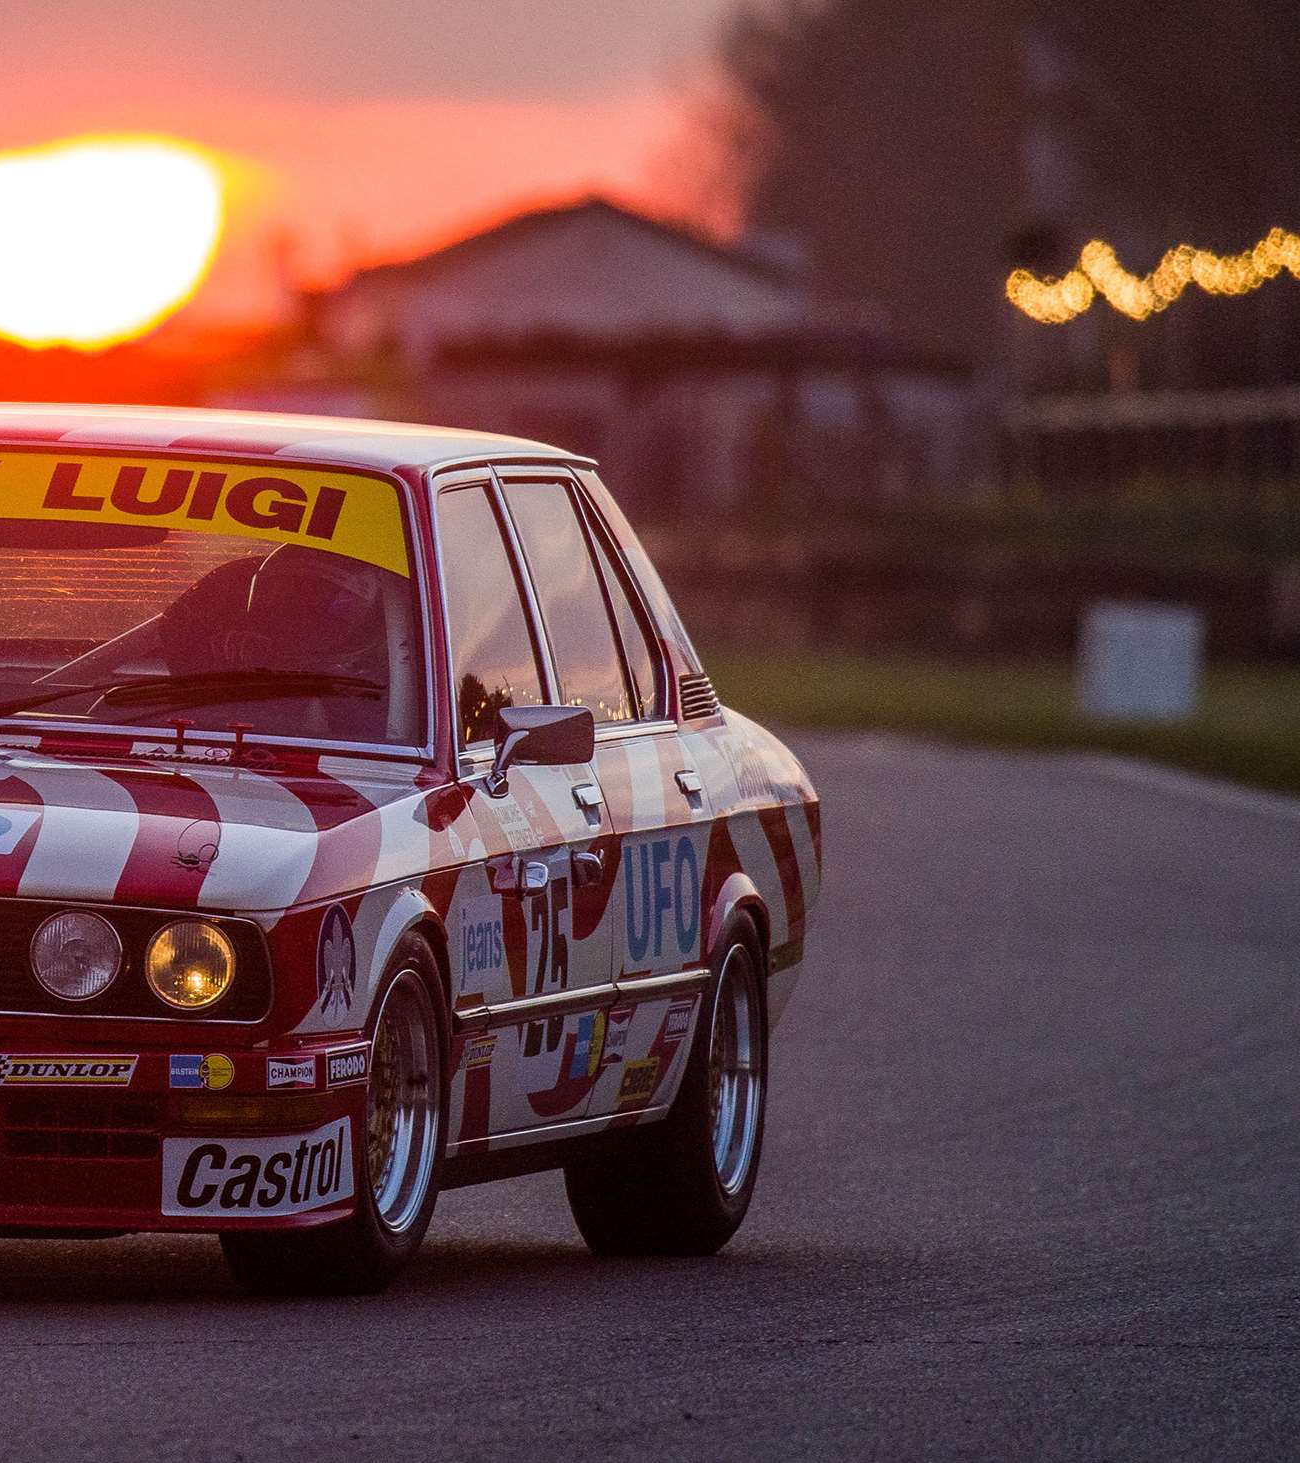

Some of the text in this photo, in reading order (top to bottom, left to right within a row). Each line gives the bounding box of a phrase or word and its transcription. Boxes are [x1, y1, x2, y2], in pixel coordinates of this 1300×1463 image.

[41, 462, 348, 540] LUIGI
[624, 836, 700, 961] UFO
[459, 908, 501, 991] jeans
[8, 1063, 131, 1077] DUNLOP
[170, 1066, 200, 1076] BILSTEIN
[270, 1064, 314, 1078] CHAMPION
[330, 1054, 366, 1080] FERODO
[176, 1126, 345, 1209] Castrol
